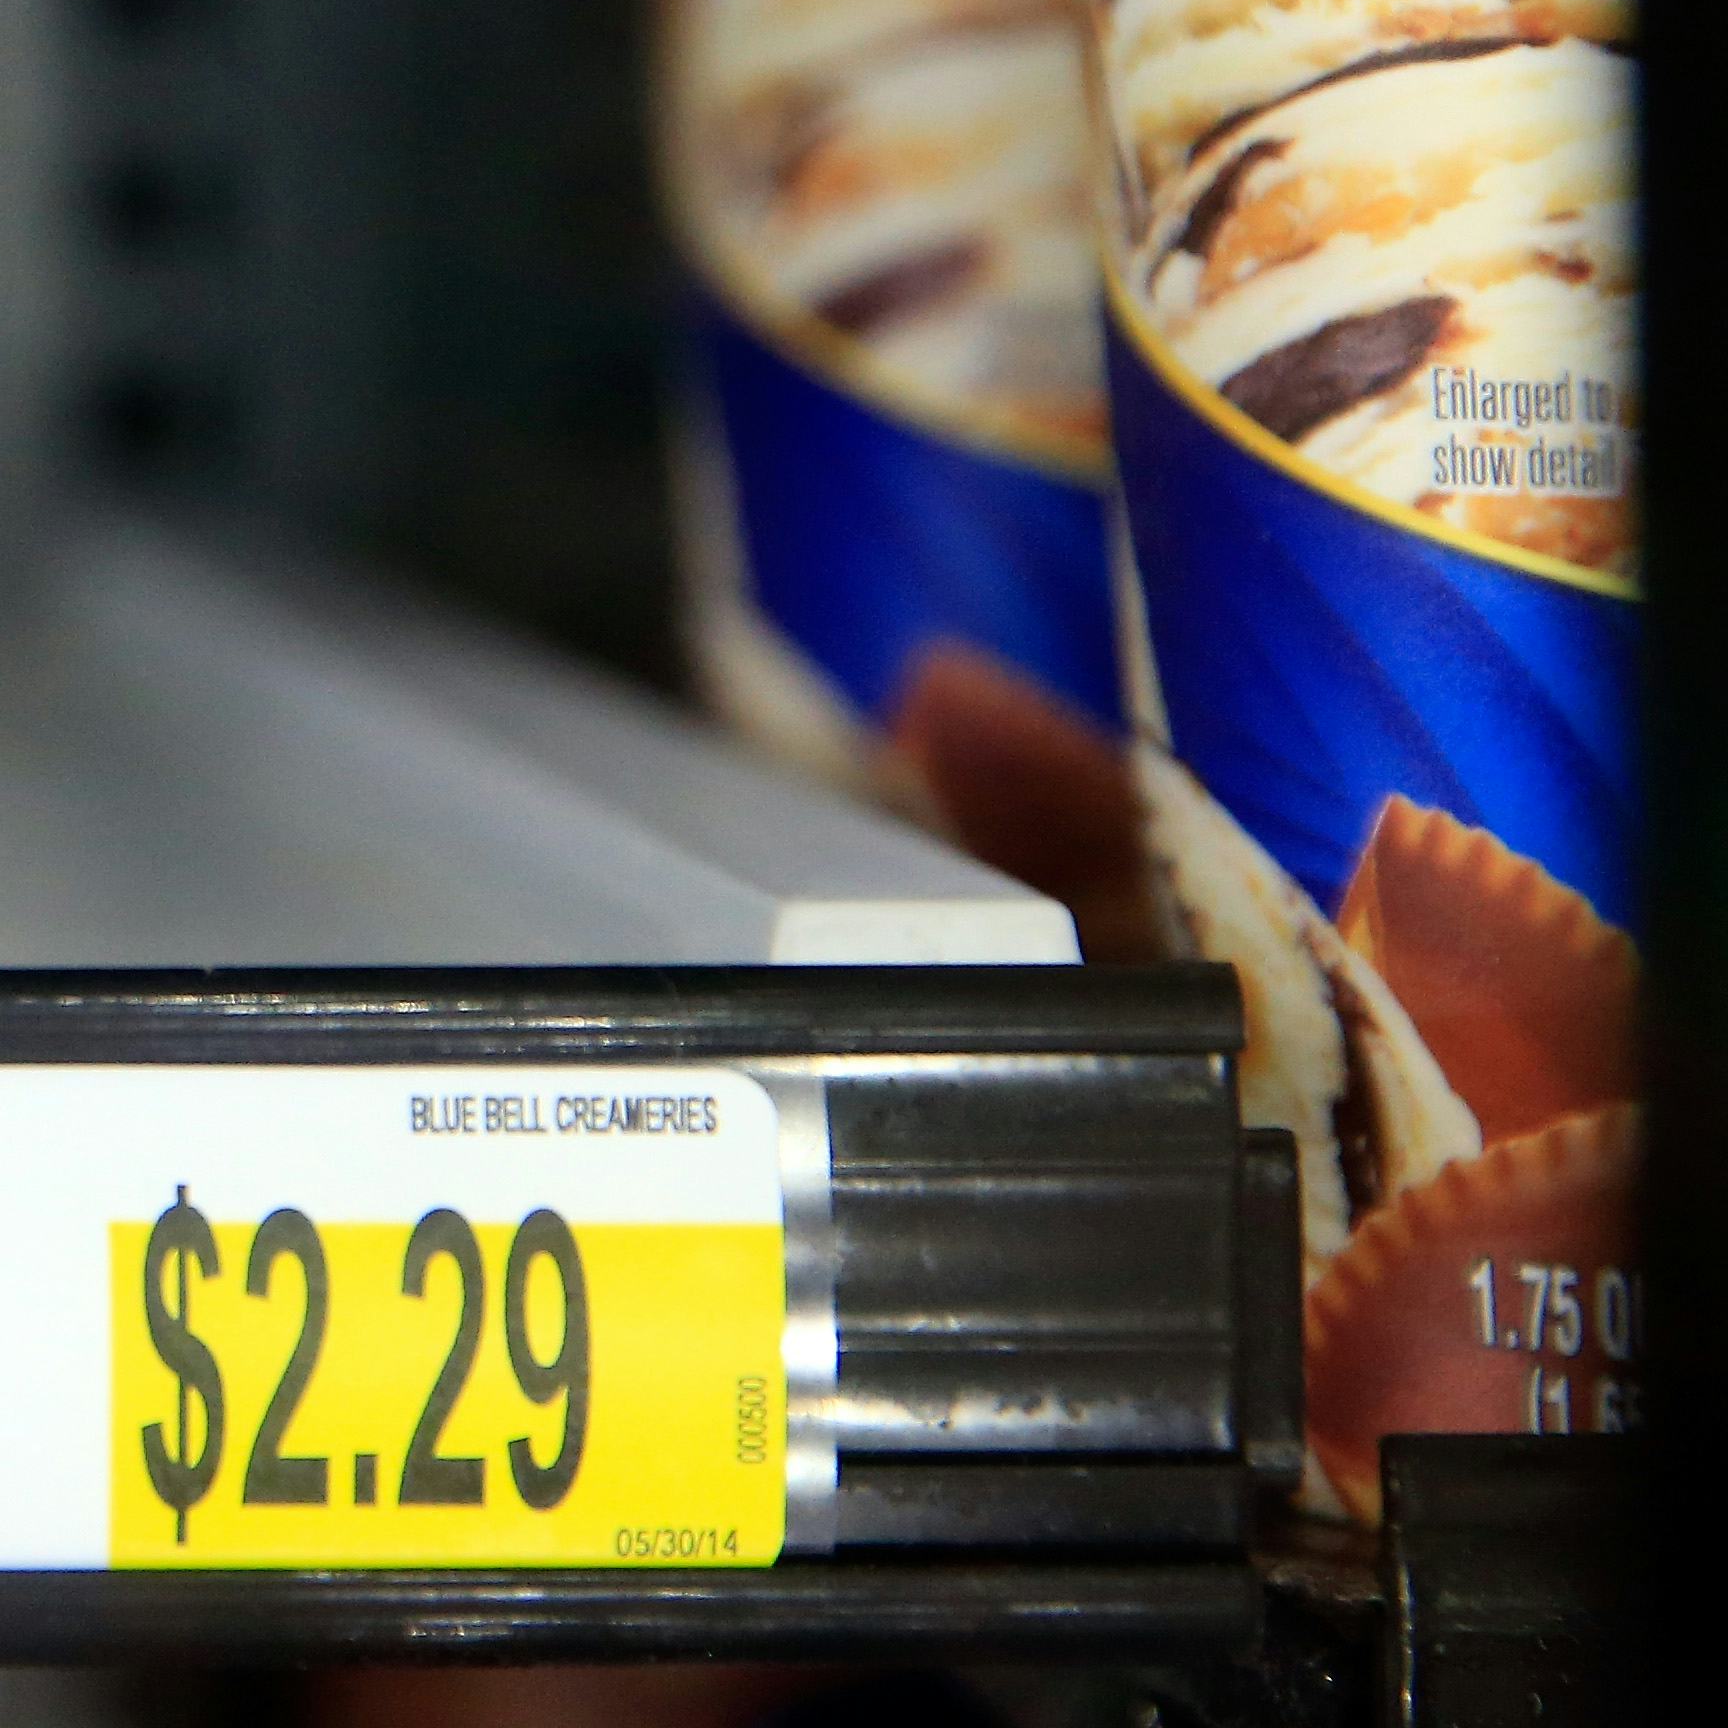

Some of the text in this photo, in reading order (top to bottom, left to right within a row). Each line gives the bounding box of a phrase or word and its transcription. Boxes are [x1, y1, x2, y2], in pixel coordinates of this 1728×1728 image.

[1433, 368, 1613, 427] Enlarged to
[1433, 433, 1618, 488] show detail
[410, 1095, 718, 1134] BLUE BELL CREAMERIES
[1470, 1257, 1584, 1357] 1.75
[141, 1183, 591, 1546] $2.29
[738, 1376, 767, 1465] 000500
[616, 1529, 740, 1559] 05/30/14
